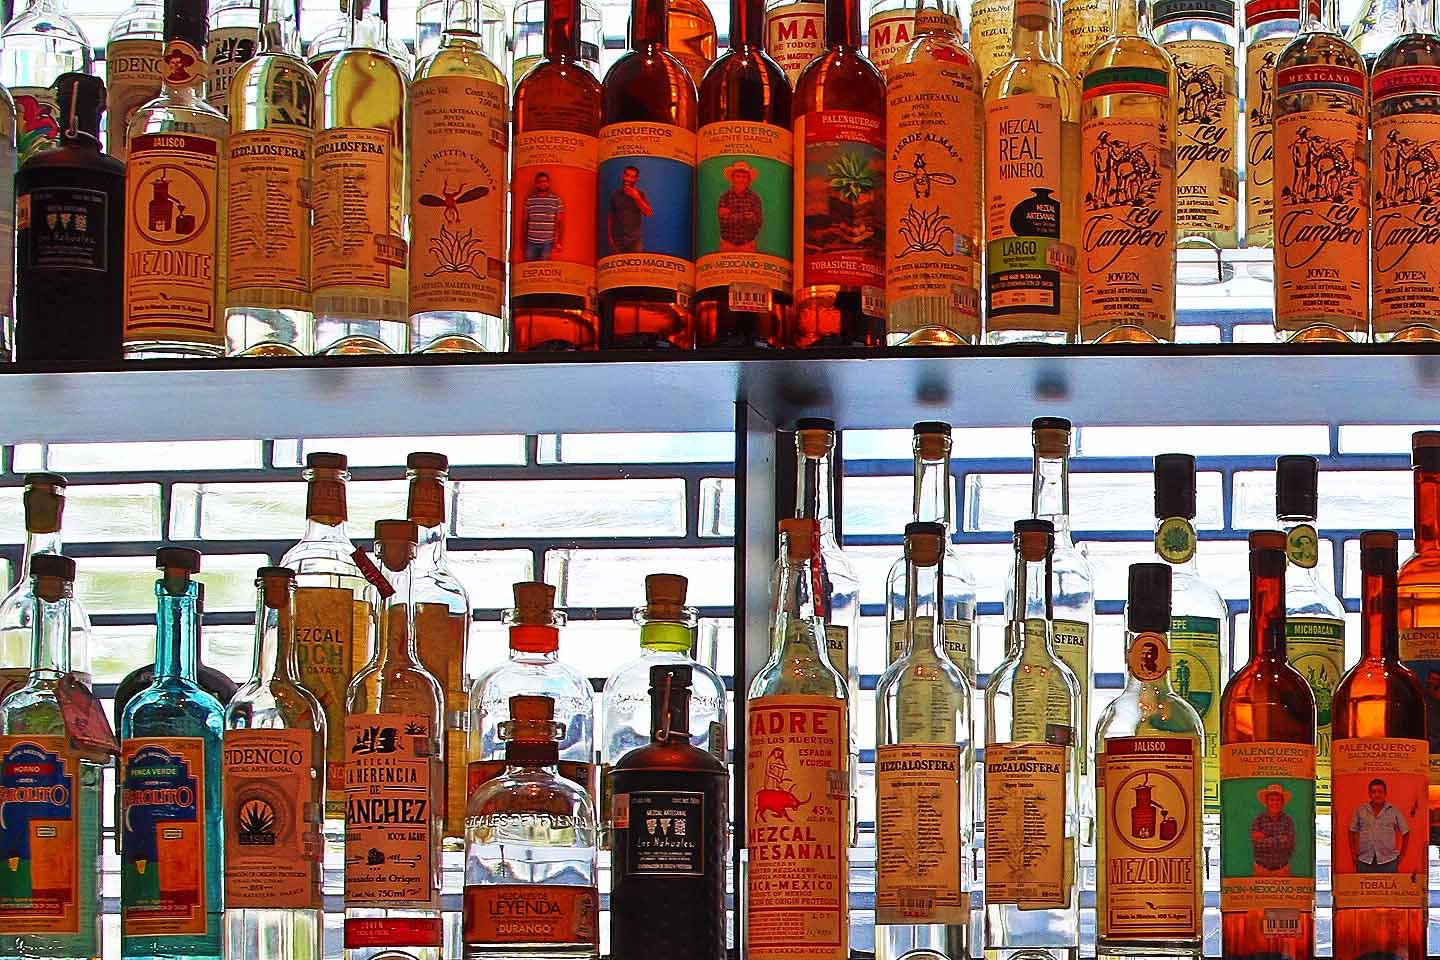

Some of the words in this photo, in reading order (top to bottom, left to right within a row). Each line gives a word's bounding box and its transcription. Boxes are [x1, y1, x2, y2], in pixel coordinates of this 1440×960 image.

[1289, 73, 1349, 83] MEXICANO
[1000, 119, 1042, 134] MEZCAL
[153, 138, 185, 148] JALISCO
[1000, 138, 1042, 159] REAL
[1000, 165, 1043, 179] MINERO
[1082, 215, 1167, 272] Campero
[1279, 209, 1363, 269] Campero
[1002, 242, 1036, 256] LARGO
[1107, 272, 1139, 283] JOVEN
[1307, 269, 1339, 279] JOVEN
[1394, 272, 1426, 281] JOVEN
[295, 629, 341, 643] EZCAL
[751, 713, 828, 734] ADRE
[767, 737, 785, 745] LOS
[789, 737, 834, 745] MUERTOS
[1134, 741, 1165, 751] JALISCO
[226, 750, 303, 767] FIDENCIO
[800, 759, 804, 767] Y
[356, 769, 417, 783] HERENCIA
[370, 785, 380, 794] DE
[346, 797, 426, 824] ÁNCHEZ
[812, 806, 832, 815] 45%
[751, 845, 835, 859] TESANAL
[1110, 858, 1191, 885] MEZONTE
[389, 875, 420, 883] Origen
[489, 900, 561, 915] LEYENDA
[499, 924, 551, 933] DURANGO
